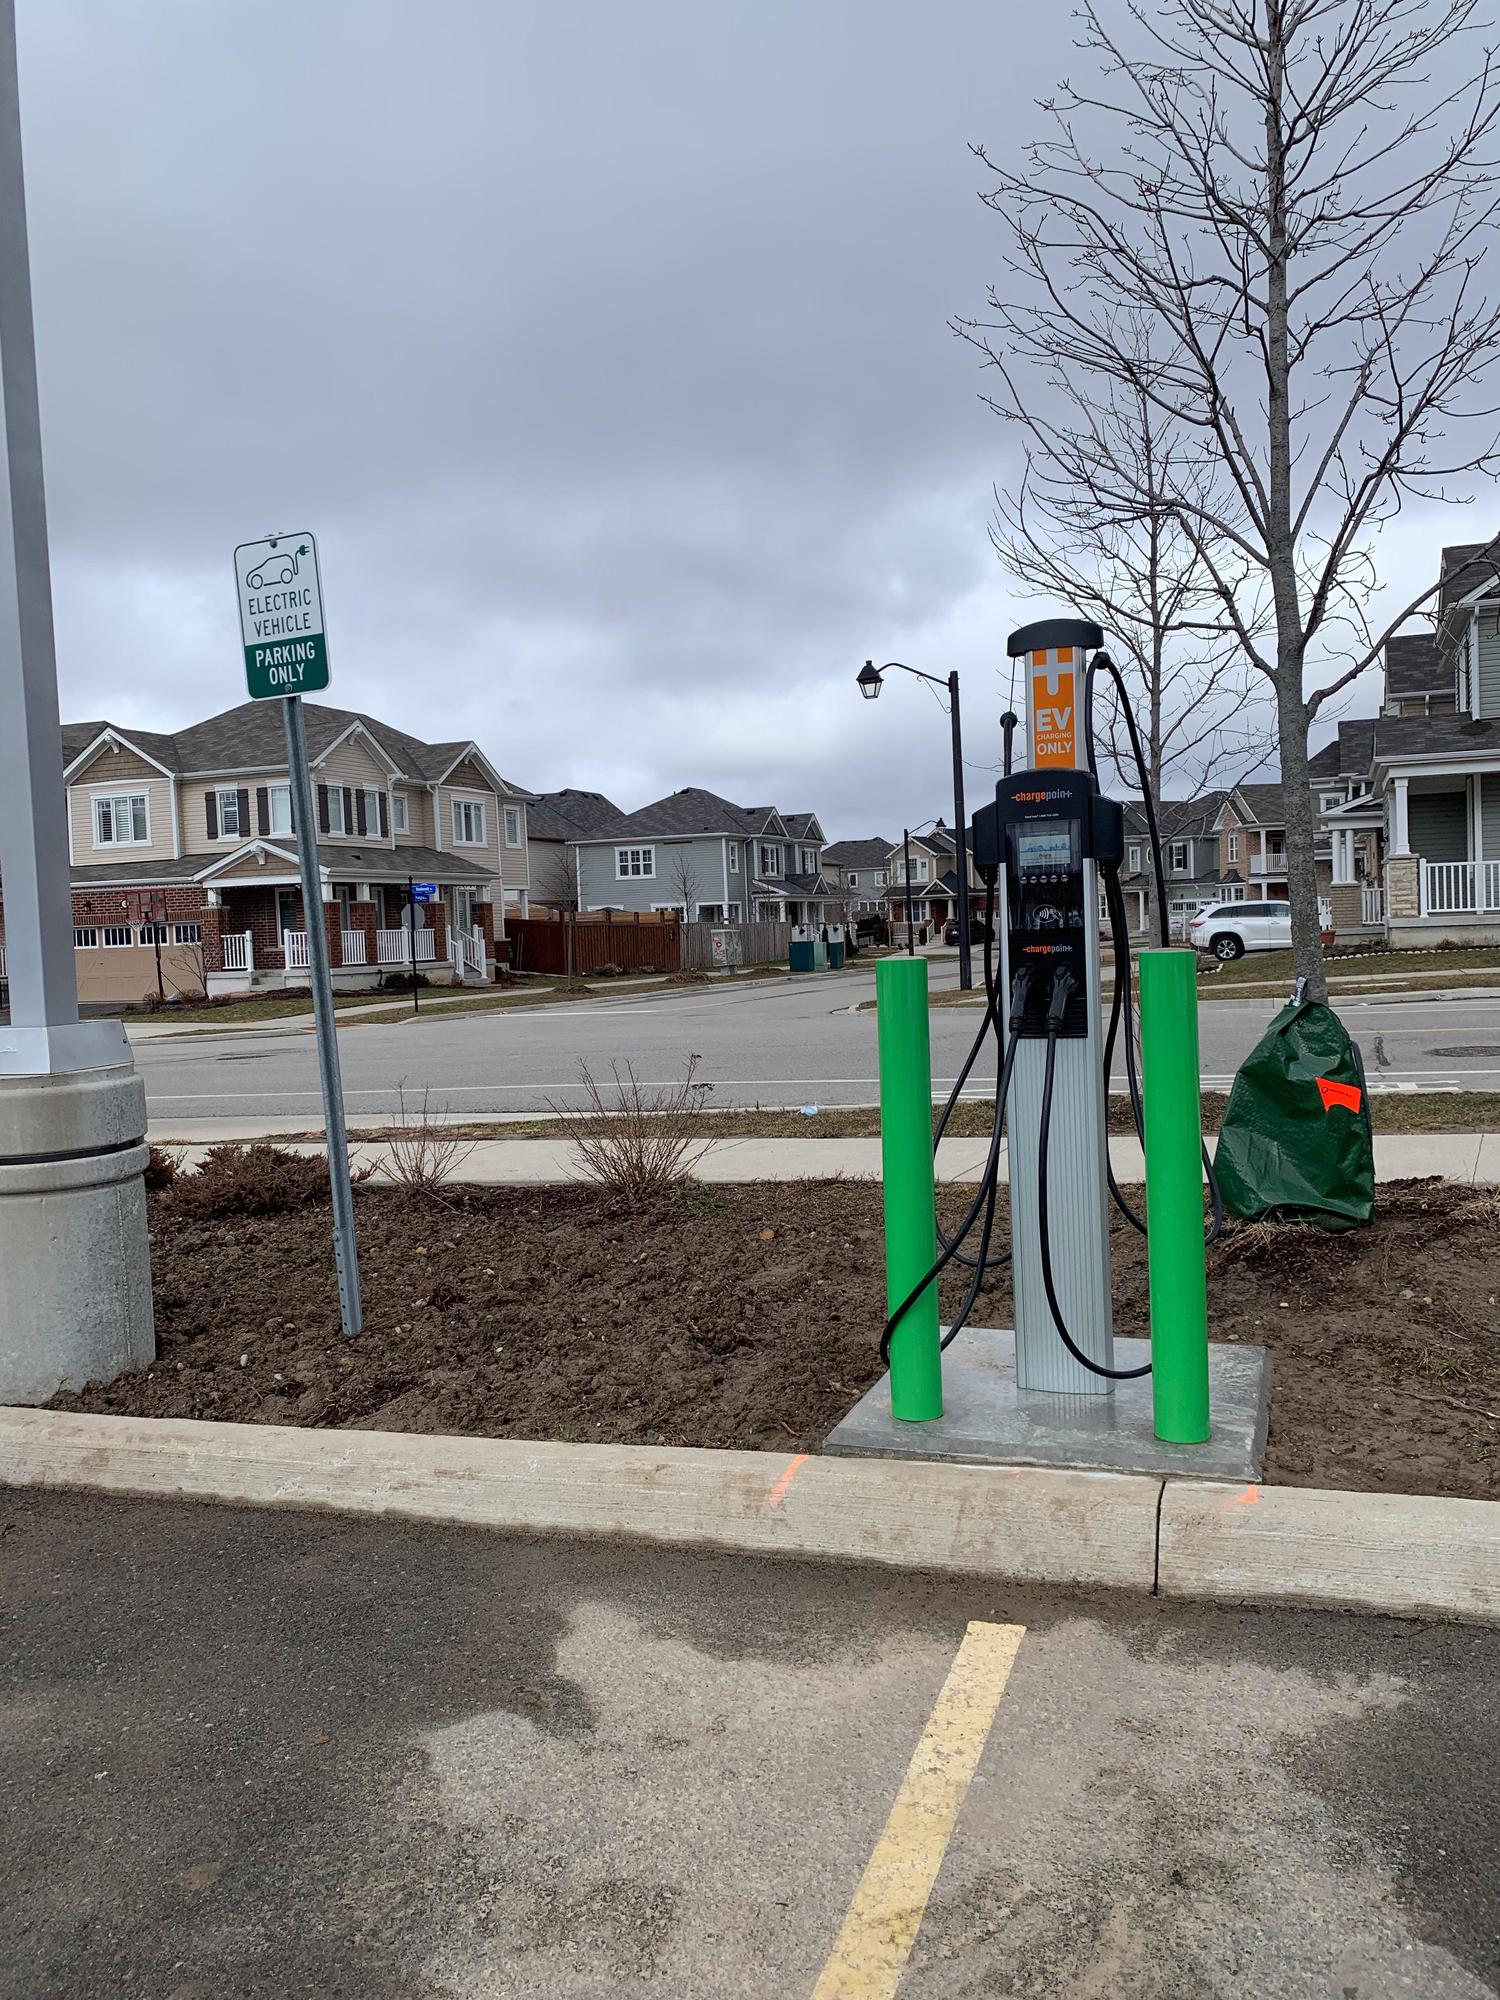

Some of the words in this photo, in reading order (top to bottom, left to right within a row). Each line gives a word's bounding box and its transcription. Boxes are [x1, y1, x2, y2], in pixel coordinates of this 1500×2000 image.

[249, 588, 311, 615] ELECTRIC
[254, 612, 311, 637] VEHICLE
[255, 641, 315, 667] PARKING
[269, 663, 305, 685] ONLY
[1036, 707, 1072, 732] EV
[1037, 732, 1072, 740] CHARGING
[1037, 741, 1072, 755] ONLY
